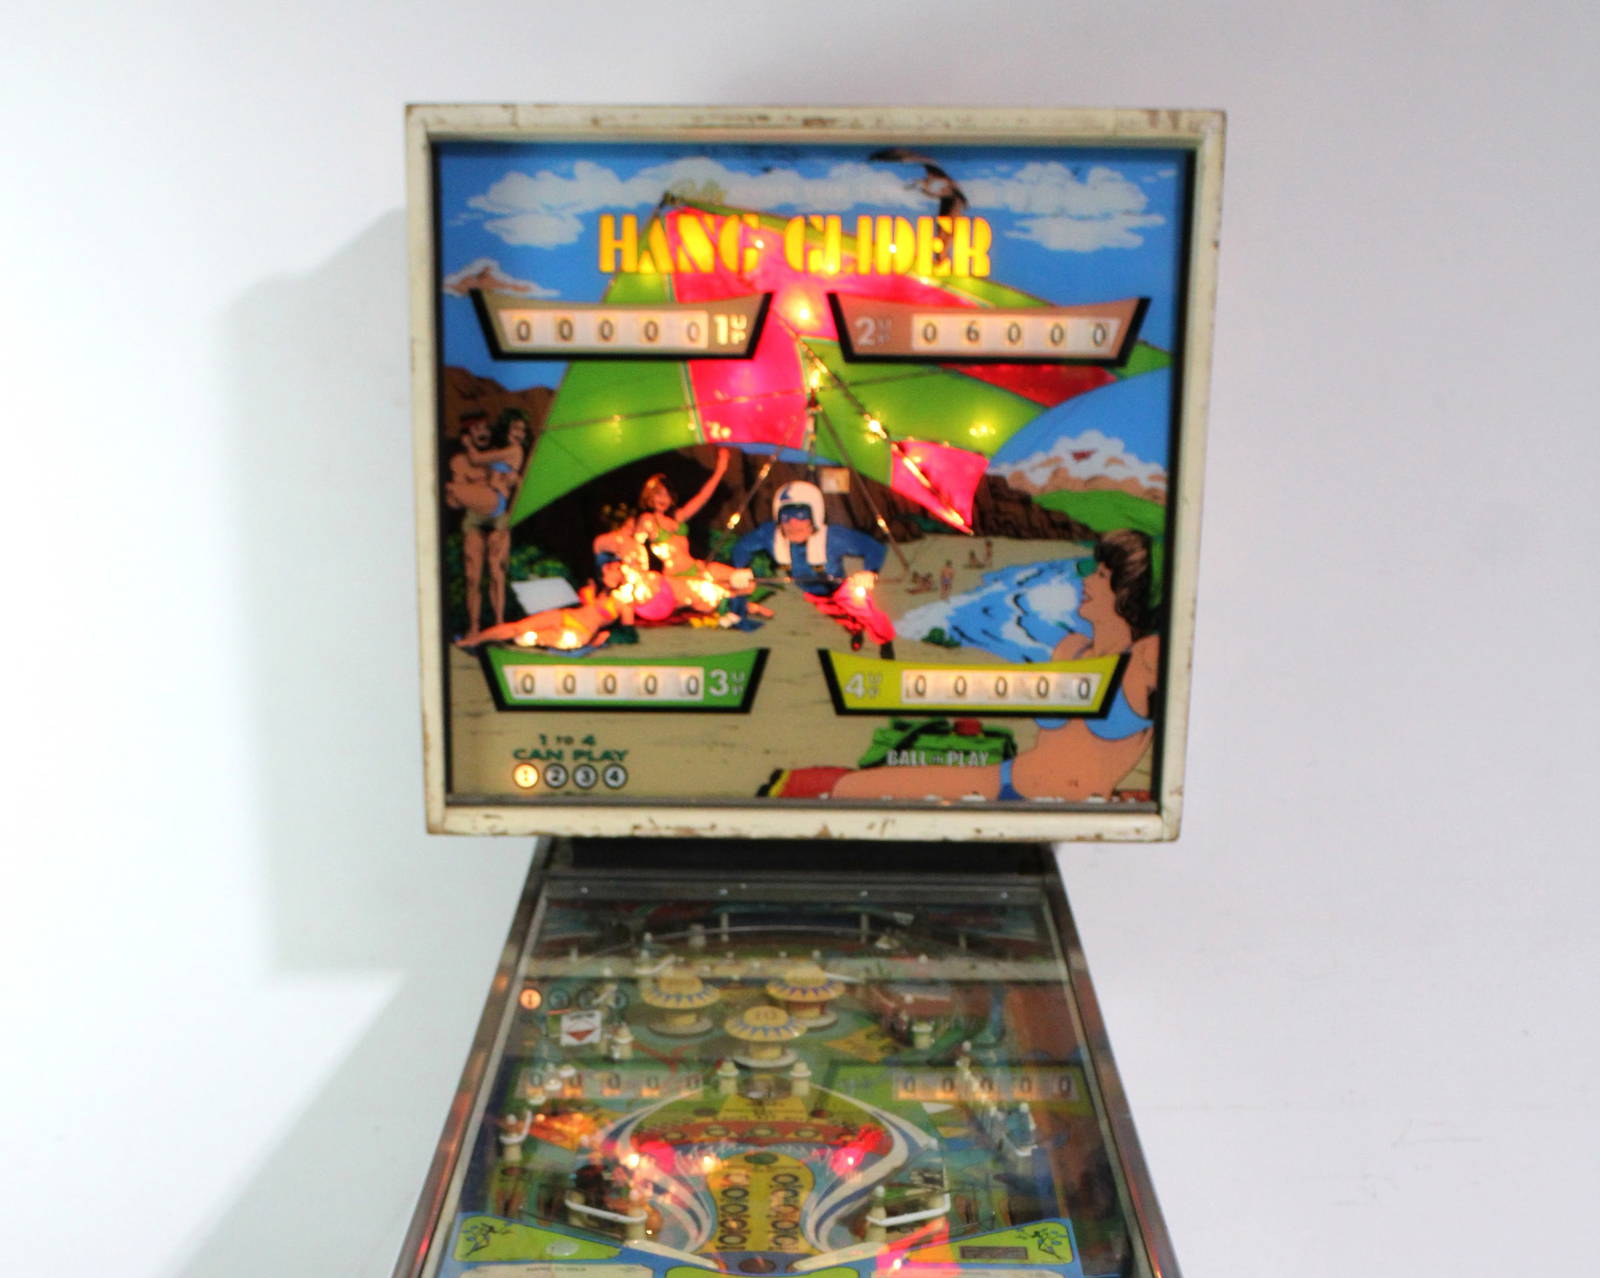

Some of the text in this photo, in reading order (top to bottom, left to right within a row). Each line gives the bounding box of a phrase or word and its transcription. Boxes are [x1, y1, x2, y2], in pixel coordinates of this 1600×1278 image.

[599, 213, 992, 276] HANG GLIDER
[714, 314, 729, 345] 1
[855, 317, 876, 346] 2
[710, 669, 728, 697] 3
[845, 673, 864, 699] 4
[539, 734, 547, 746] 1
[581, 734, 596, 746] 4
[512, 748, 629, 761] CAN PLAY
[886, 749, 927, 767] BALL
[946, 750, 989, 767] PLAY
